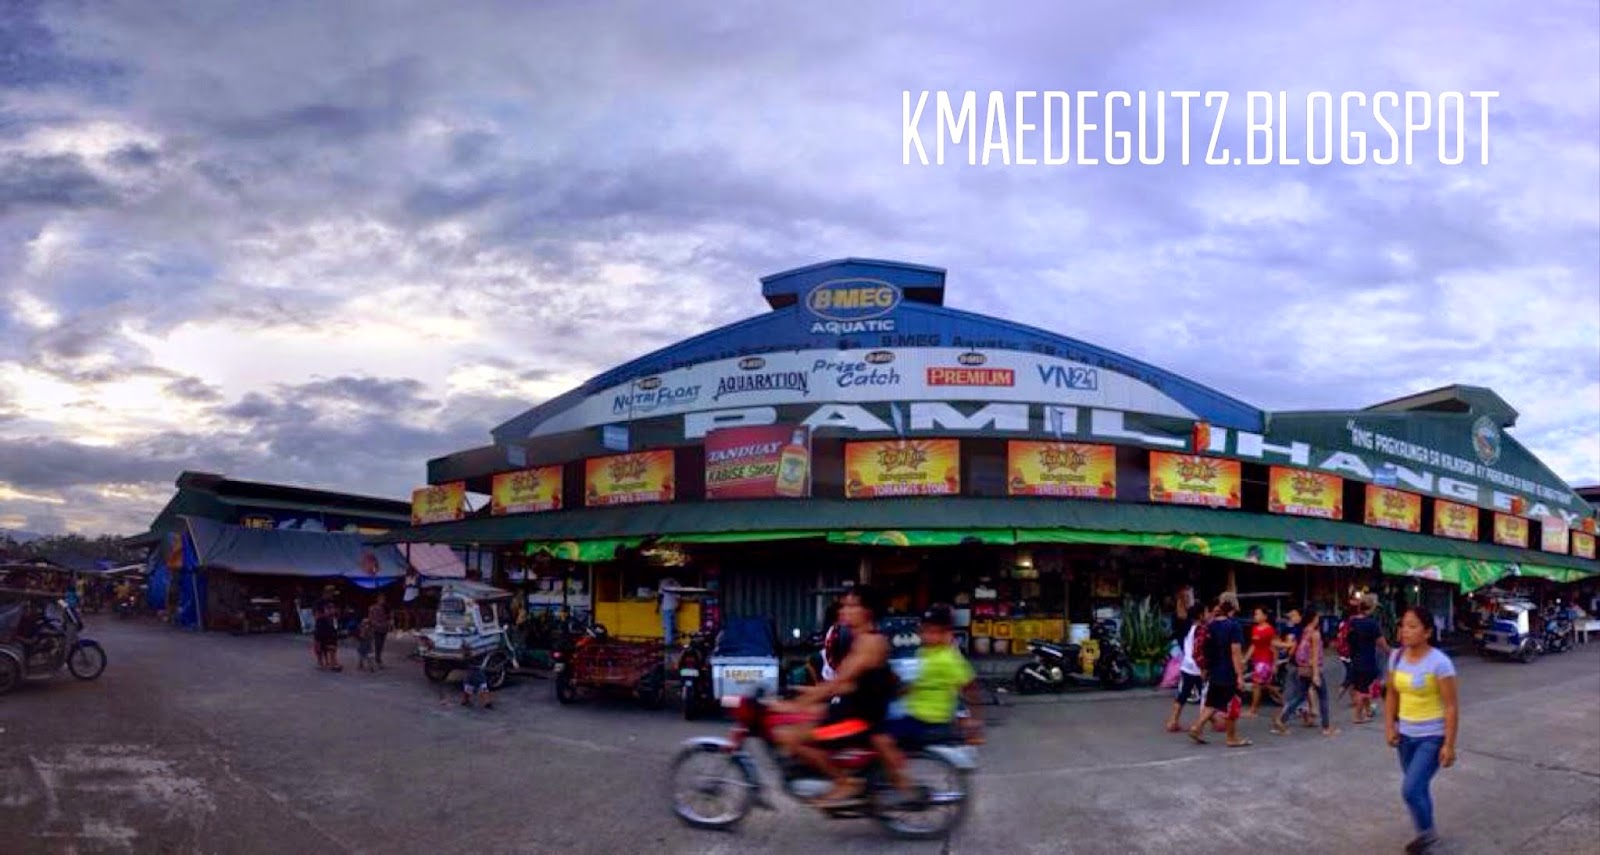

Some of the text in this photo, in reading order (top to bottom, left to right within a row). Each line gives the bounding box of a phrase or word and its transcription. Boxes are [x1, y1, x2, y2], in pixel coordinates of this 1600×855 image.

[813, 287, 893, 309] B-MEG
[810, 319, 895, 334] AQUATIC
[812, 359, 866, 373] Prize
[716, 371, 809, 396] AQUARATION
[837, 367, 900, 388] Catch
[931, 370, 1011, 385] PREMIUM
[685, 401, 1479, 502] PAMILIHANG
[707, 441, 783, 461] TANDUAY
